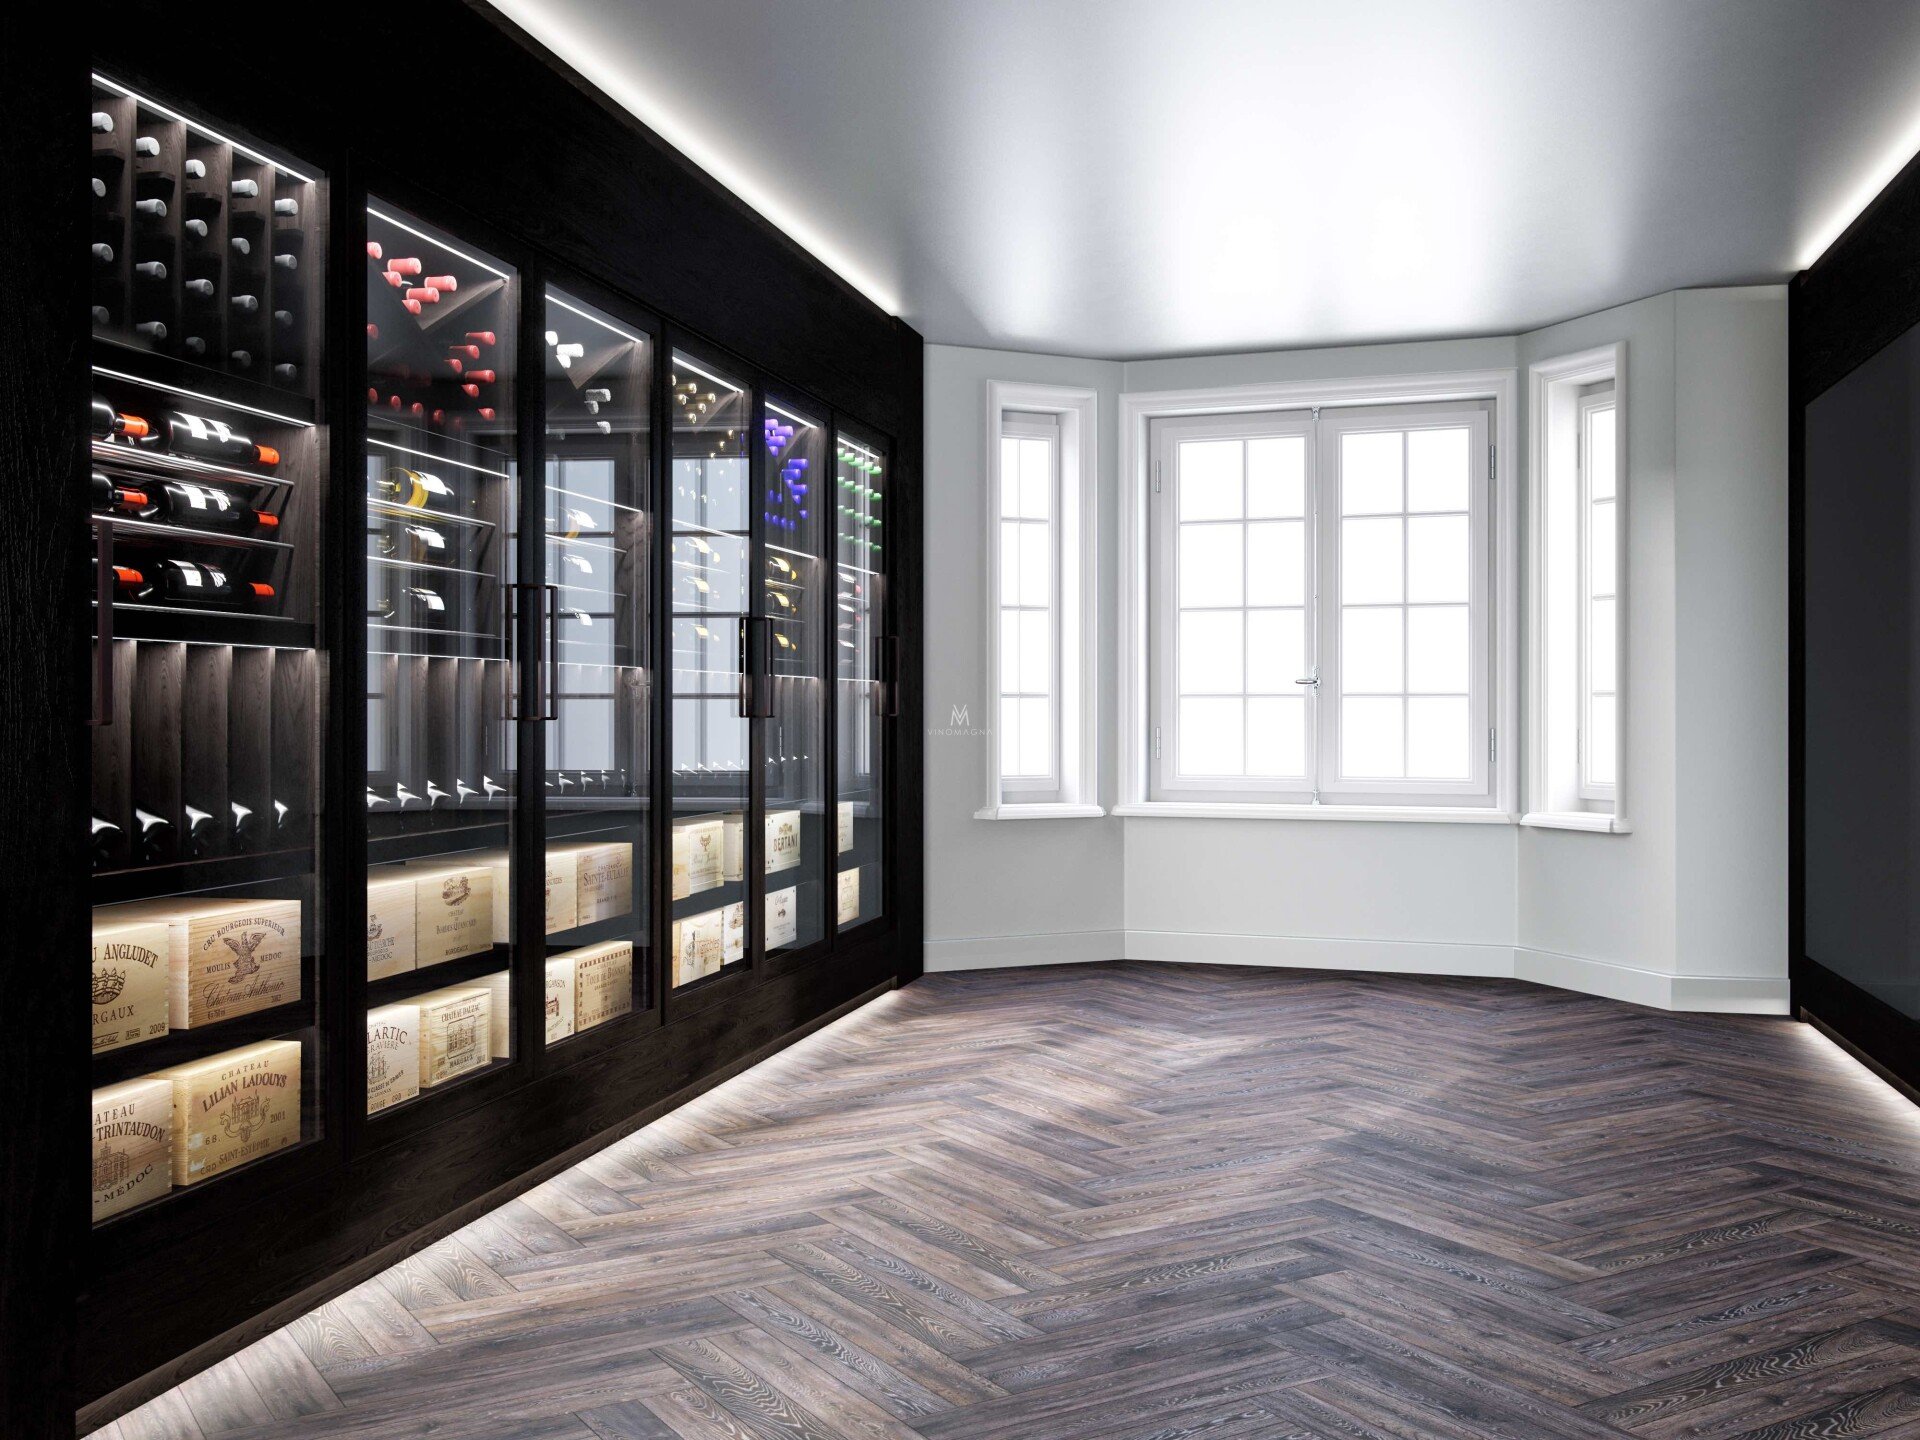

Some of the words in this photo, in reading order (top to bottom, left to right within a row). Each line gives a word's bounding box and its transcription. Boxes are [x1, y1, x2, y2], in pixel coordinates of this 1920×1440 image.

[773, 833, 798, 852] BERTANI
[202, 934, 216, 951] CRU
[216, 918, 252, 938] BOURGEOIS
[253, 917, 286, 937] SUPERIEUR
[103, 942, 159, 969] ANGLUDET
[206, 962, 231, 974] MOULIS
[149, 1022, 166, 1035] 2009
[221, 1060, 270, 1081] CHATEAU
[202, 1079, 238, 1113] LILIAN
[242, 1072, 288, 1089] LADOUYS
